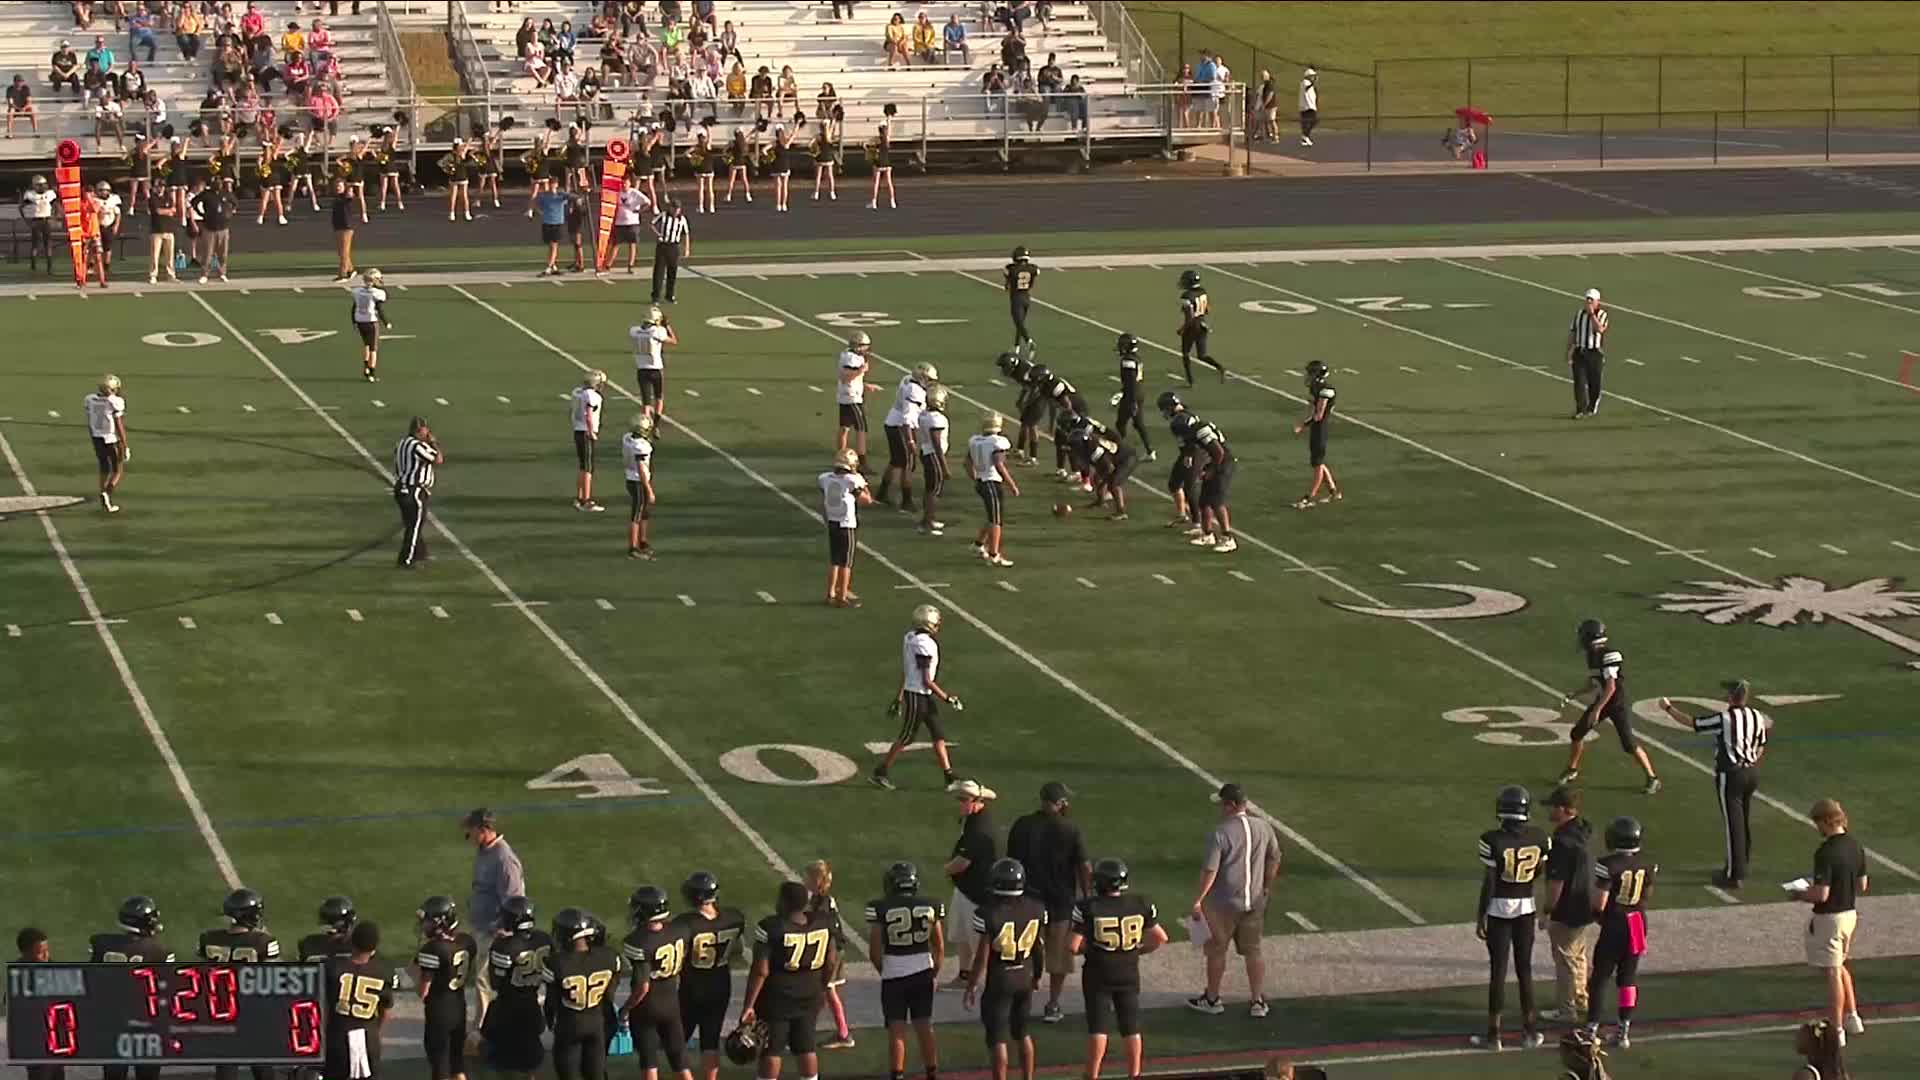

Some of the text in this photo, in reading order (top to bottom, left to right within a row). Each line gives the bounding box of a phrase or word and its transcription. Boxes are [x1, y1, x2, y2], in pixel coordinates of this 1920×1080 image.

[1502, 846, 1542, 884] 12
[1616, 870, 1645, 907] 11
[885, 906, 934, 947] 23
[998, 918, 1041, 962] 44
[1093, 915, 1145, 953] 58
[650, 938, 684, 980] 31
[692, 928, 741, 969] 67
[784, 928, 830, 971] 77
[336, 972, 385, 1019] 15
[561, 969, 613, 1011] 32
